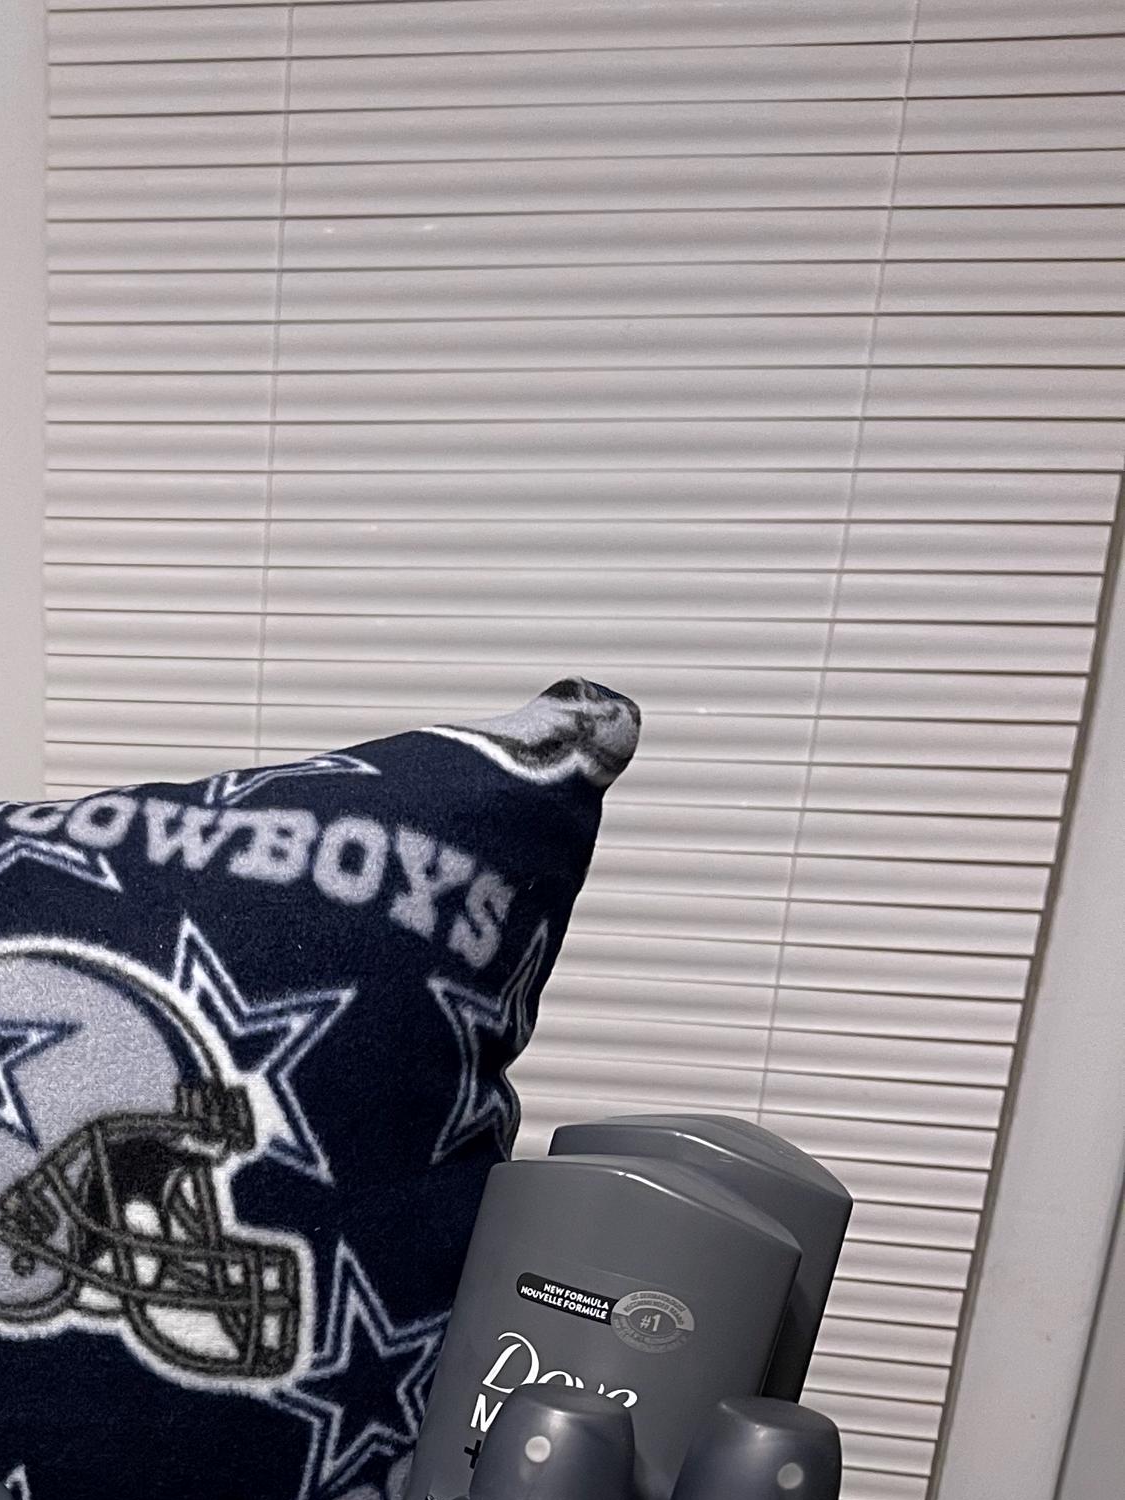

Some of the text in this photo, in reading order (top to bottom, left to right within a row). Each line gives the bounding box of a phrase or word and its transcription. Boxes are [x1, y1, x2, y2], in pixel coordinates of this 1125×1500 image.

[6, 795, 516, 969] COWBOYS
[520, 1285, 563, 1308] NOUVELLE
[562, 1299, 608, 1320] FORMULE
[543, 1282, 565, 1297] NEW
[564, 1289, 610, 1311] FORMULA
[639, 1313, 662, 1333] #1
